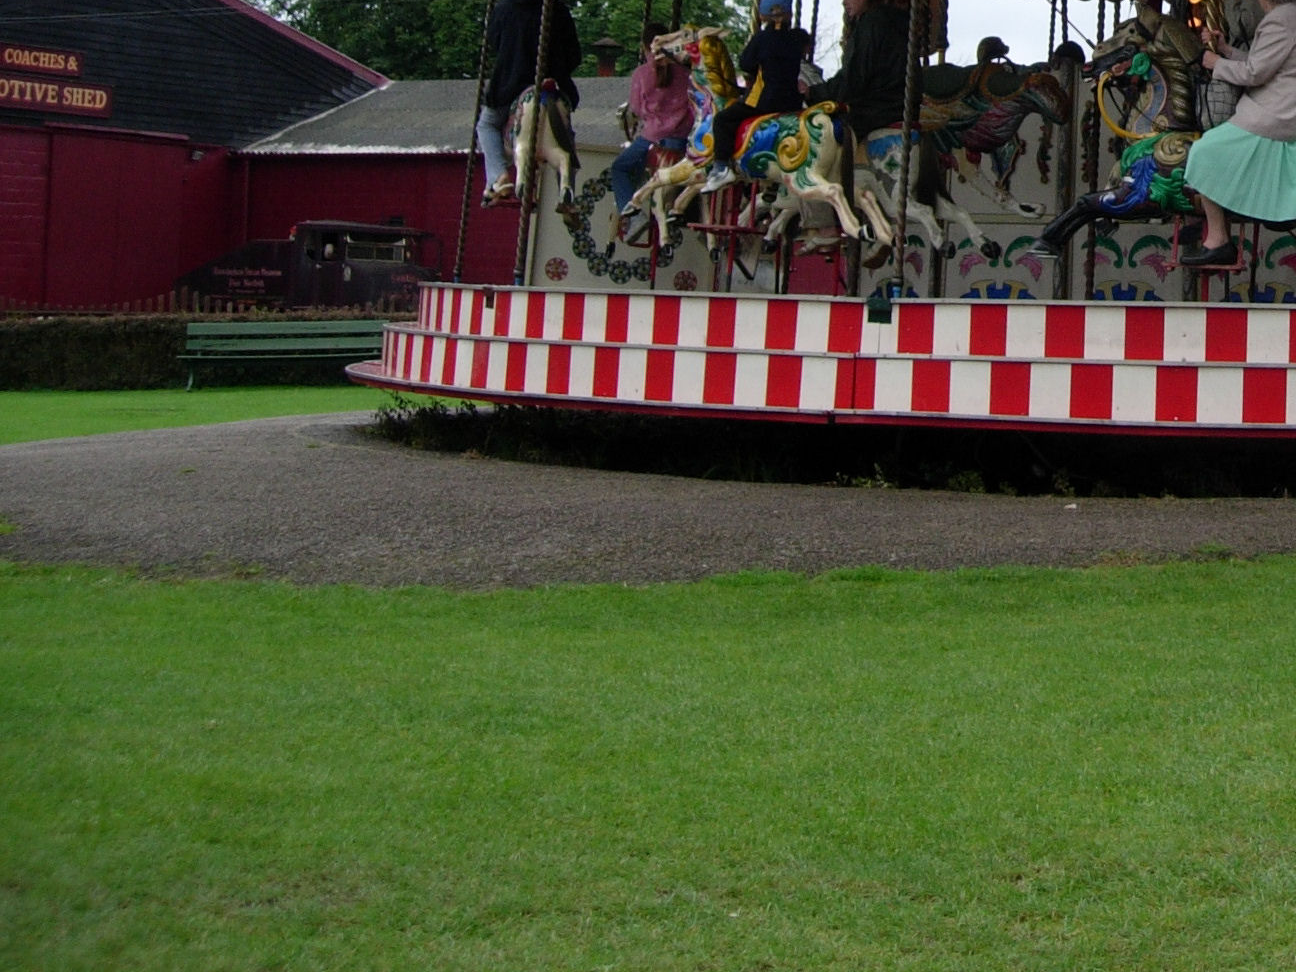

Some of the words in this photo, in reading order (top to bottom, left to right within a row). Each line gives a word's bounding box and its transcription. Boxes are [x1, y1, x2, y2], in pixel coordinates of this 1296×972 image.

[4, 48, 66, 69] COACHES
[67, 56, 79, 71] &
[62, 86, 108, 109] SHED
